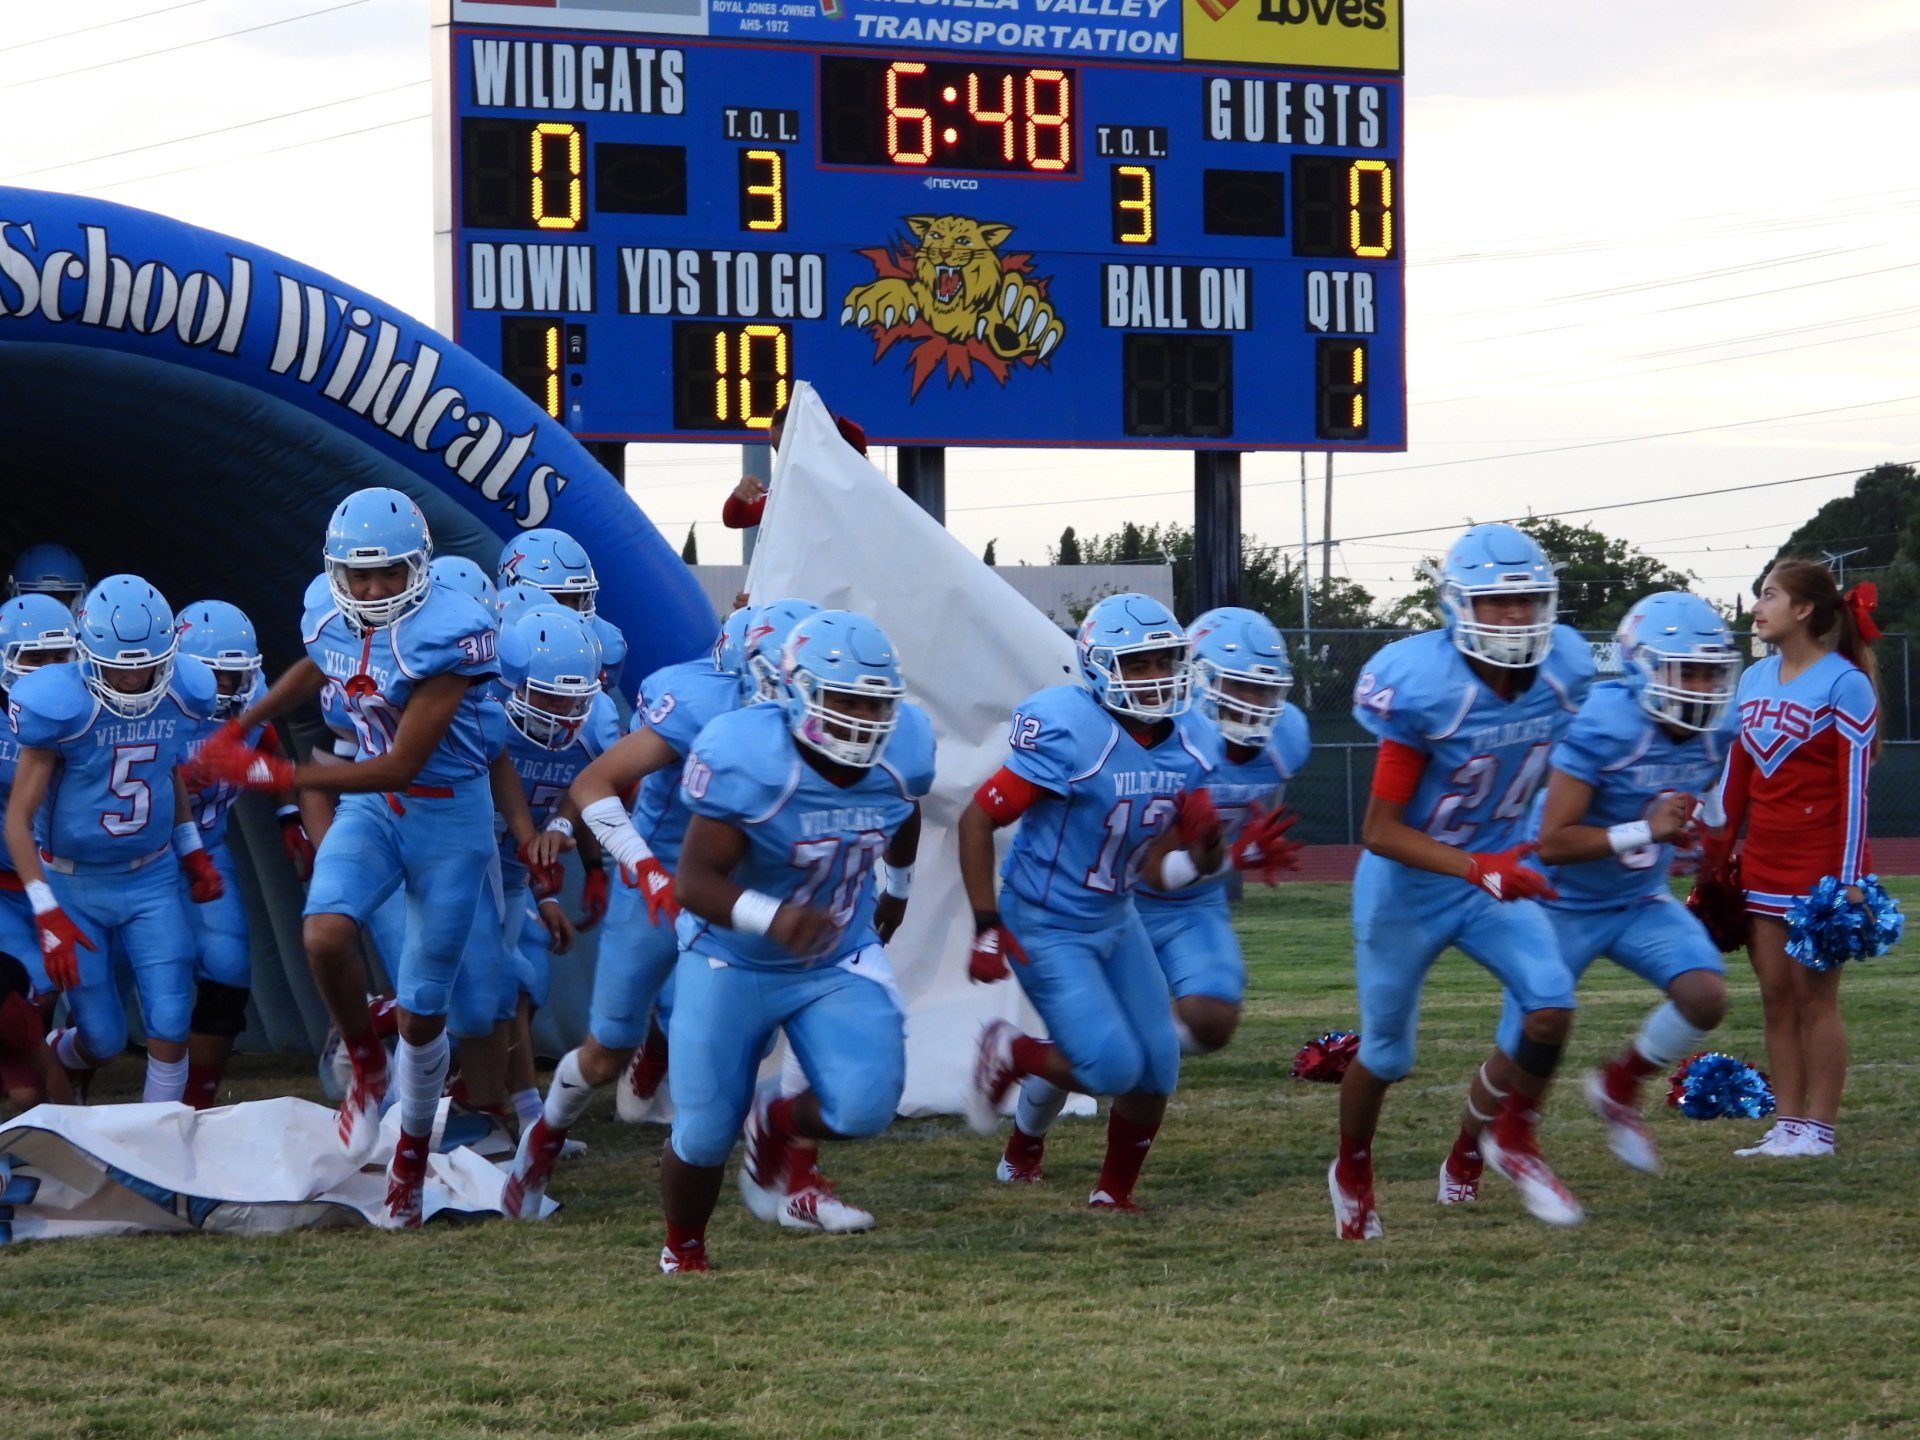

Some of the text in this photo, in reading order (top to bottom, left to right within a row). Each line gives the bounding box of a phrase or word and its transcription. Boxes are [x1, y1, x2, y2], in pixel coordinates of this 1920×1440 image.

[712, 0, 741, 14] ROYAL
[746, 2, 776, 15] JONES
[766, 20, 789, 32] 1972
[854, 14, 1179, 54] TRANSPORTATION
[472, 39, 684, 115] WILDCATS
[1210, 78, 1379, 148] GUESTS
[886, 61, 1070, 171] 6:48
[531, 123, 580, 230] 0
[746, 150, 782, 231] 3
[1118, 166, 1151, 243] 3
[1349, 160, 1391, 257] 0
[472, 243, 591, 312] DOWN
[622, 248, 823, 318] YDS TO GO
[1108, 265, 1246, 330] BALL ON
[1307, 271, 1374, 333] QTR
[0, 220, 568, 528] School Wildcats
[546, 327, 558, 418] 1
[715, 325, 787, 428] 10
[1353, 347, 1363, 428] 1
[457, 629, 496, 665] 30
[9, 699, 21, 735] 5
[95, 720, 176, 746] WILDCATS
[1009, 713, 1041, 750] 12
[100, 744, 159, 837] 5
[509, 757, 576, 783] DCATS
[1113, 771, 1187, 796] WILDCATS
[1426, 741, 1552, 846] 24
[790, 829, 887, 928] 70
[1084, 796, 1180, 893] 12
